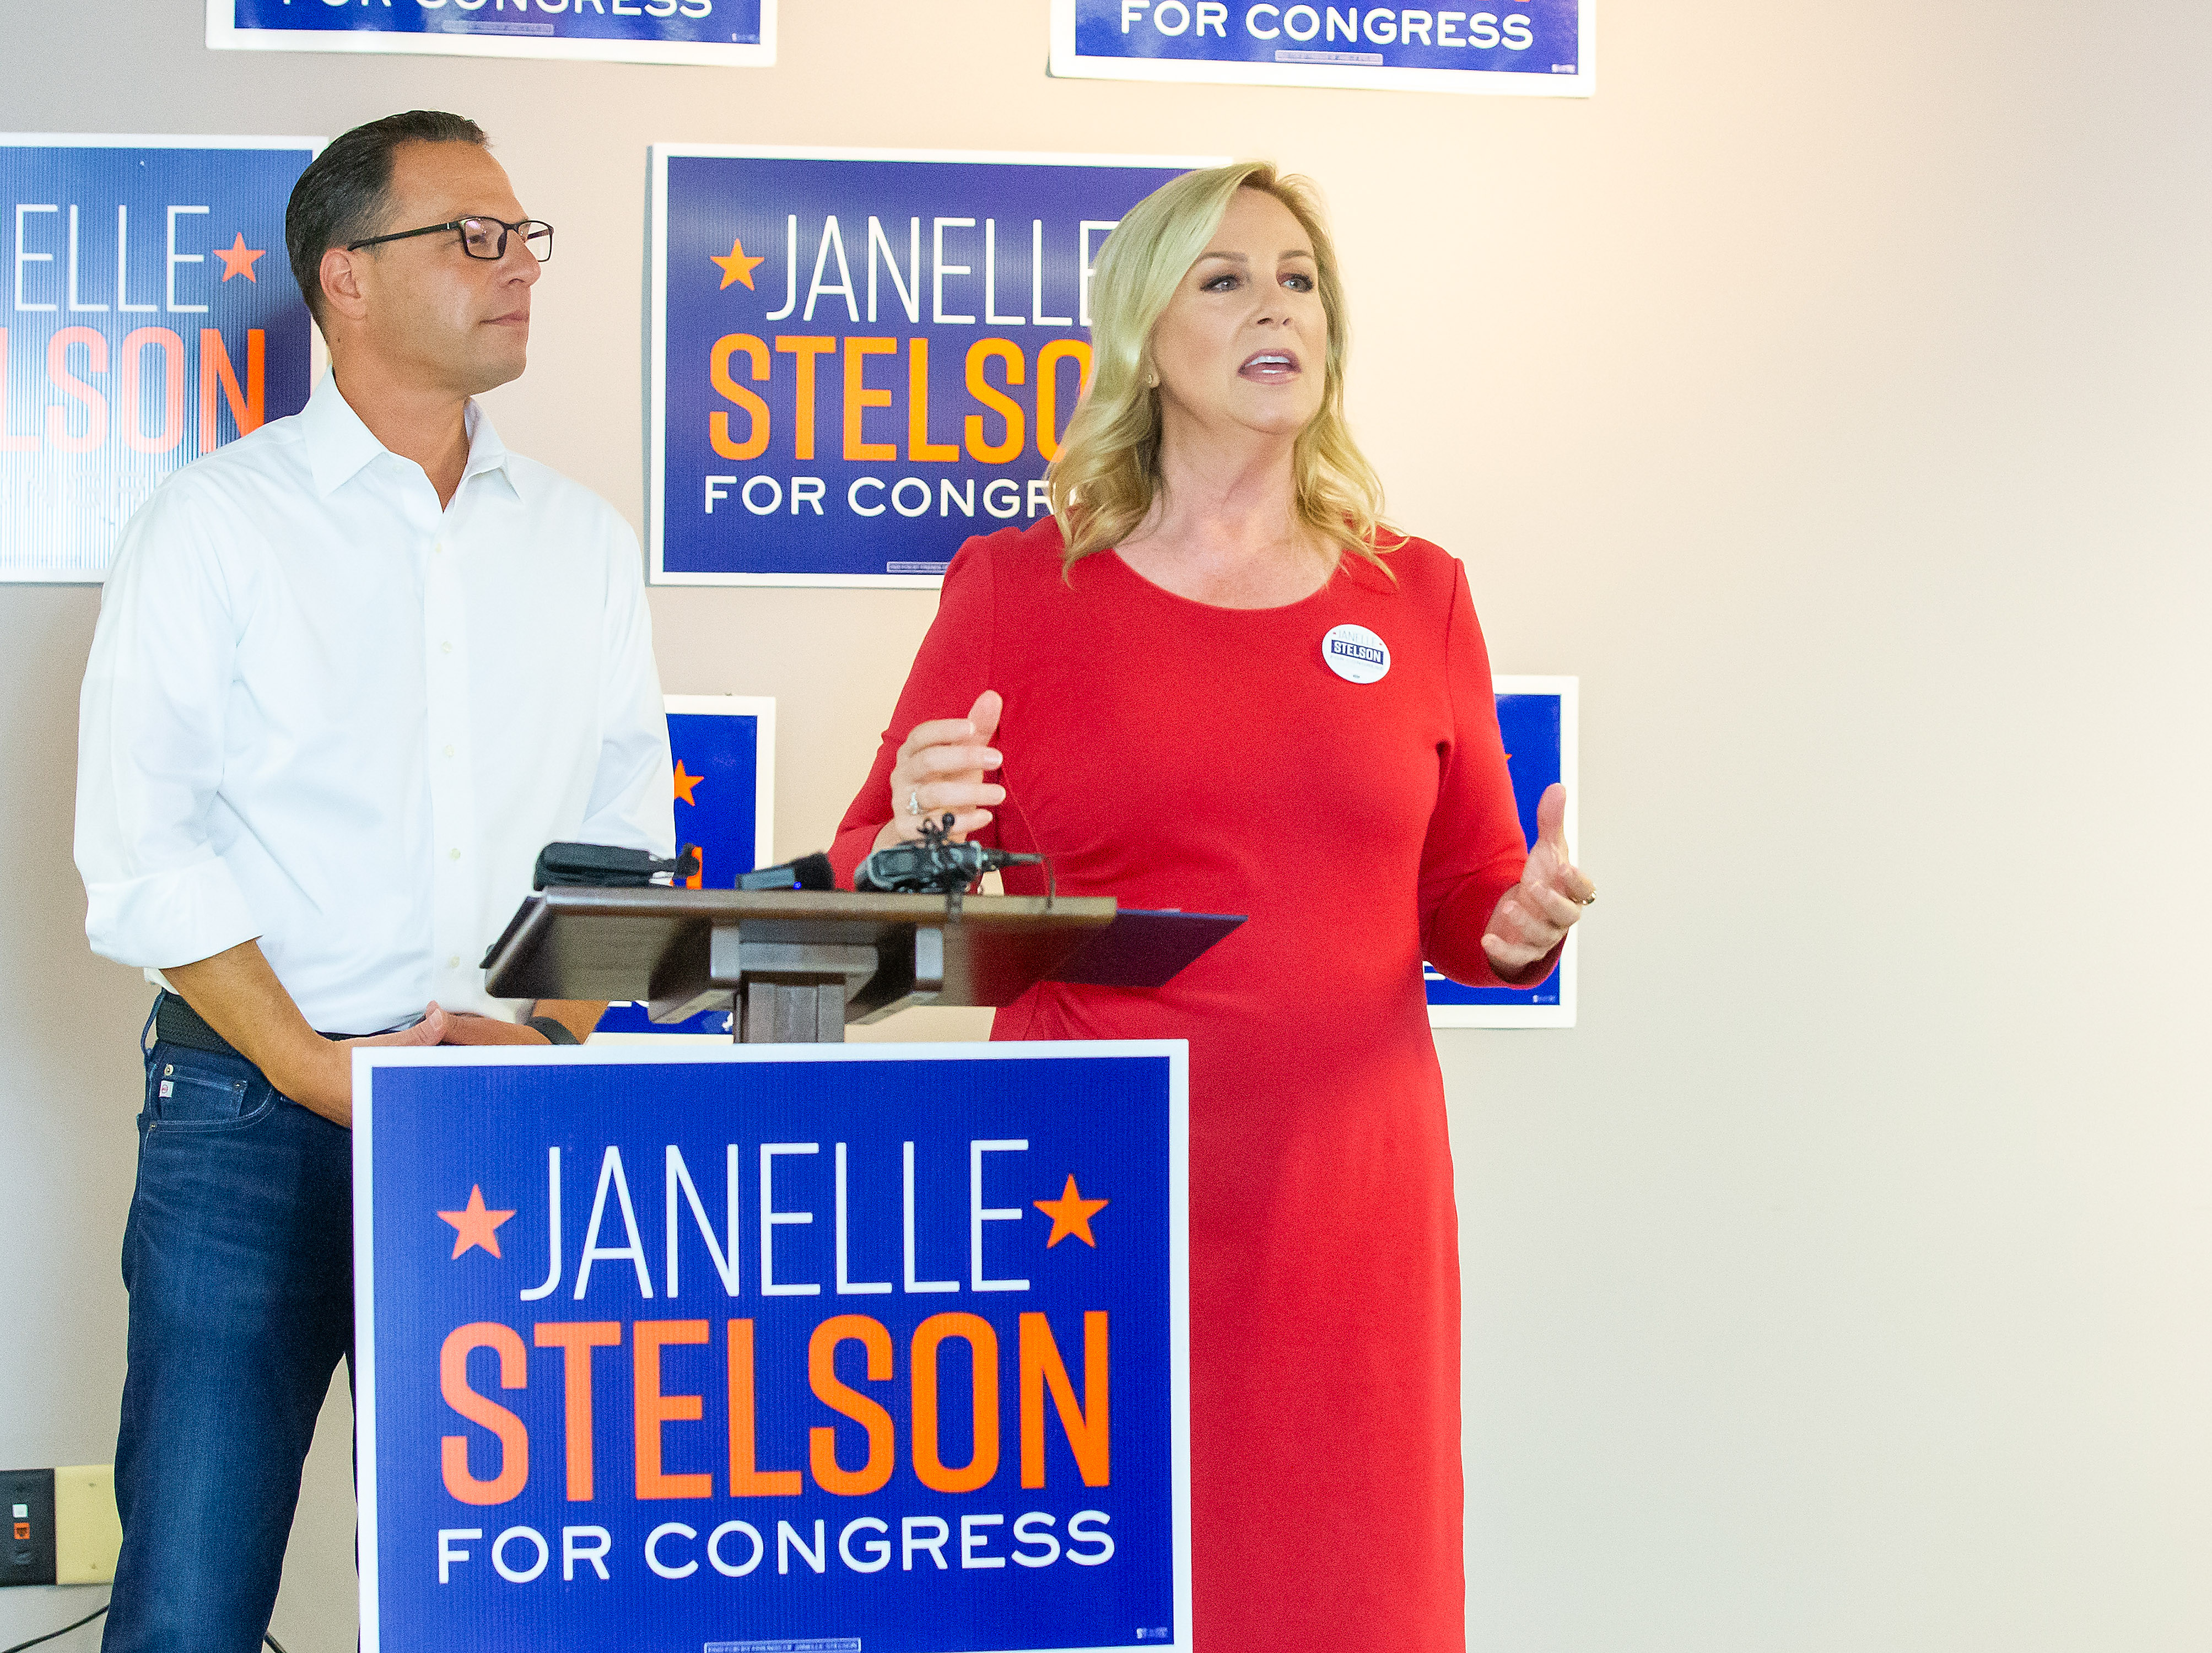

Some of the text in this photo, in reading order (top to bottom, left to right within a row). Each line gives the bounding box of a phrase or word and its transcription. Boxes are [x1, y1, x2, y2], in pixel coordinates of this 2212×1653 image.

[1121, 0, 1534, 51] FOR CONGRESS
[13, 203, 210, 314] ELLE
[765, 214, 1120, 327] JANELLE
[704, 474, 1078, 518] FOR CONGR
[1334, 641, 1382, 663] STELSON
[519, 1139, 1031, 1301] JANELLE
[440, 1310, 1110, 1506] STELSON
[438, 1510, 1115, 1585] FOR CONGRESS
